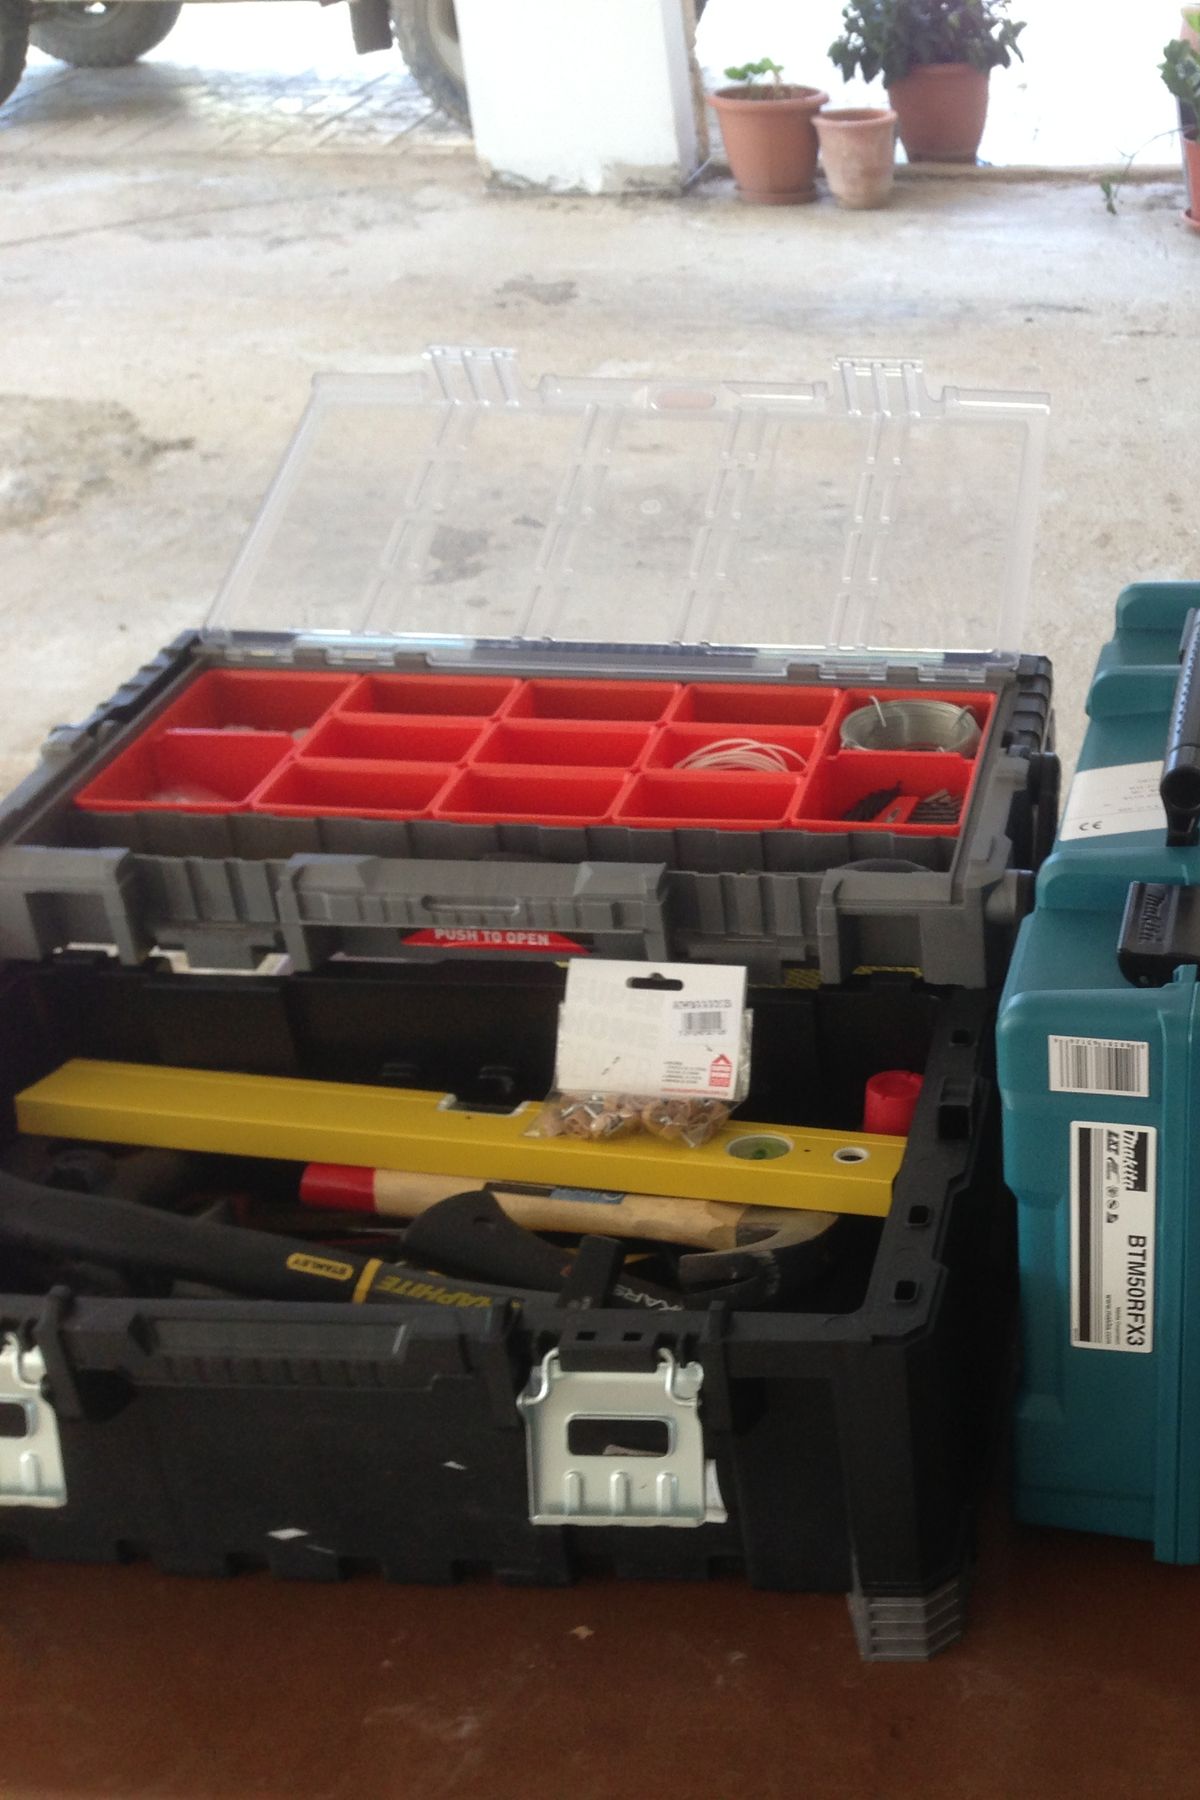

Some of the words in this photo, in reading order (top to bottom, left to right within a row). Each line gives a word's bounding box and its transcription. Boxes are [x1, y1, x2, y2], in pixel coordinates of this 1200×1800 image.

[434, 928, 478, 942] PUSH
[483, 931, 500, 943] TO
[506, 932, 550, 946] OPEN
[1122, 1130, 1140, 1190] makita
[293, 1257, 348, 1277] STANLEY
[1126, 1234, 1147, 1346] BTM50RFX3
